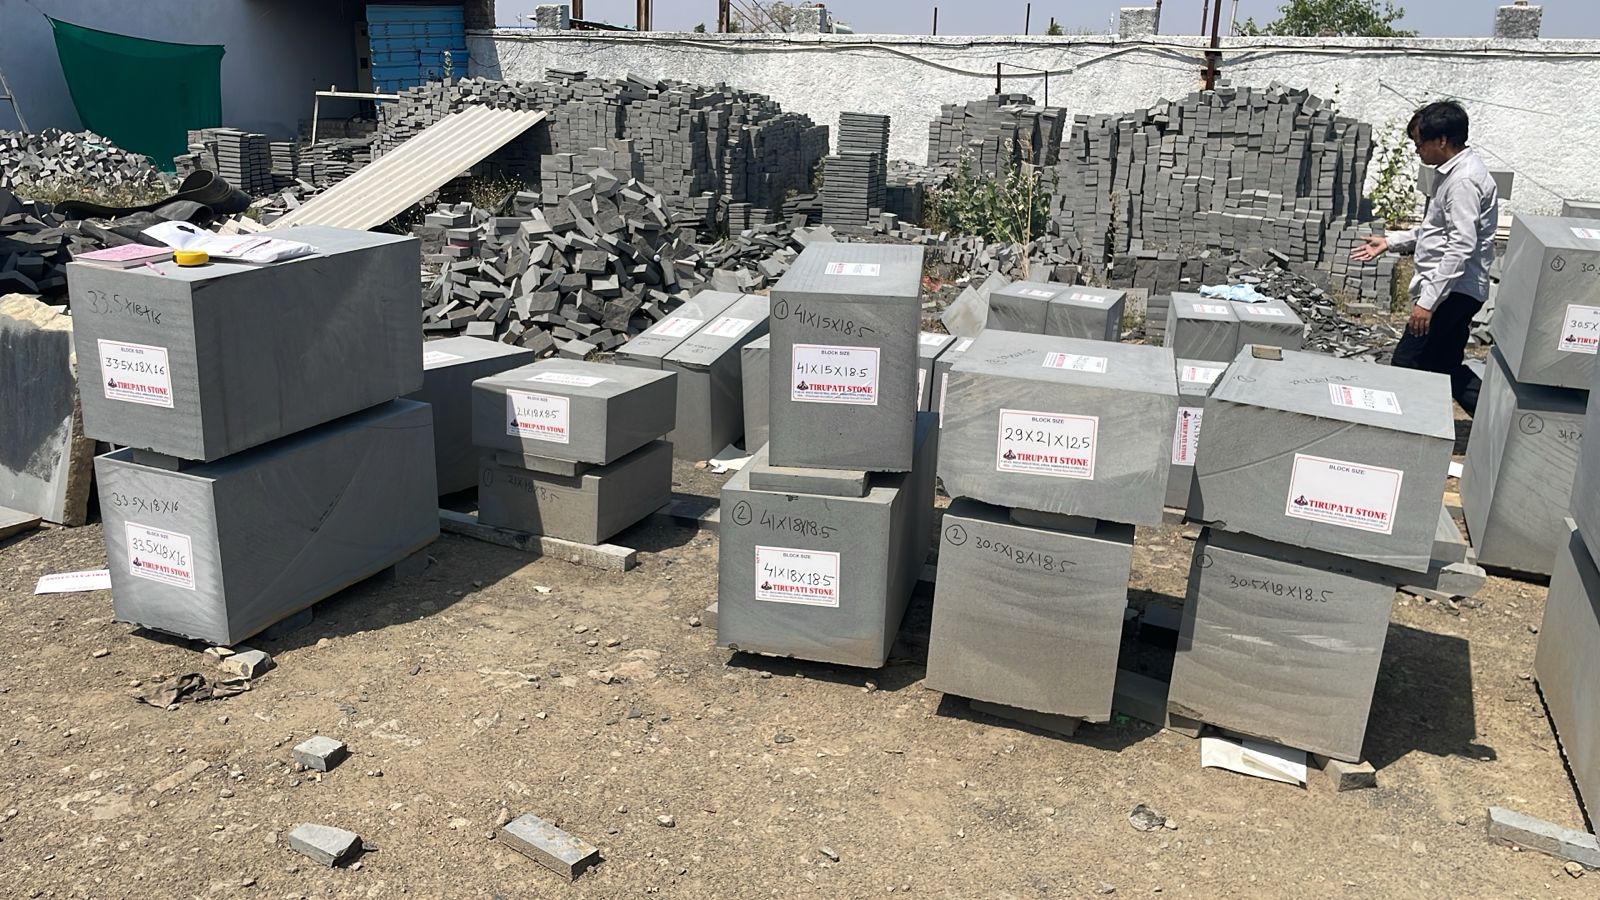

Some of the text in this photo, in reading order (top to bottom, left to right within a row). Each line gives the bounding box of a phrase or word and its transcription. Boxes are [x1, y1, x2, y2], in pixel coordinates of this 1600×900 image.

[794, 304, 874, 337] 41X15X18.5
[797, 362, 868, 378] 41X15X18.5
[117, 381, 147, 392] TIRUPATI
[148, 386, 168, 396] STONE
[809, 383, 873, 394] TIRUPATI STONE
[519, 422, 546, 432] TIRUPATI
[547, 425, 565, 434] STONE
[1016, 452, 1058, 464] TIRUPATI
[1059, 456, 1088, 467] STONE
[1328, 464, 1350, 473] BLOCK
[112, 492, 179, 514] 33.5X18X16
[1309, 499, 1353, 515] TIRUPATI
[1355, 508, 1387, 521] STONE
[760, 510, 839, 539] 41X18X18.5
[976, 536, 1077, 572] 30.5X18X18.5
[142, 560, 170, 574] TIRUPATI
[170, 567, 190, 578] STONE
[772, 583, 808, 594] TIRUPATI
[808, 587, 834, 597] STONE
[1230, 575, 1334, 603] 30.5X18X18.5
